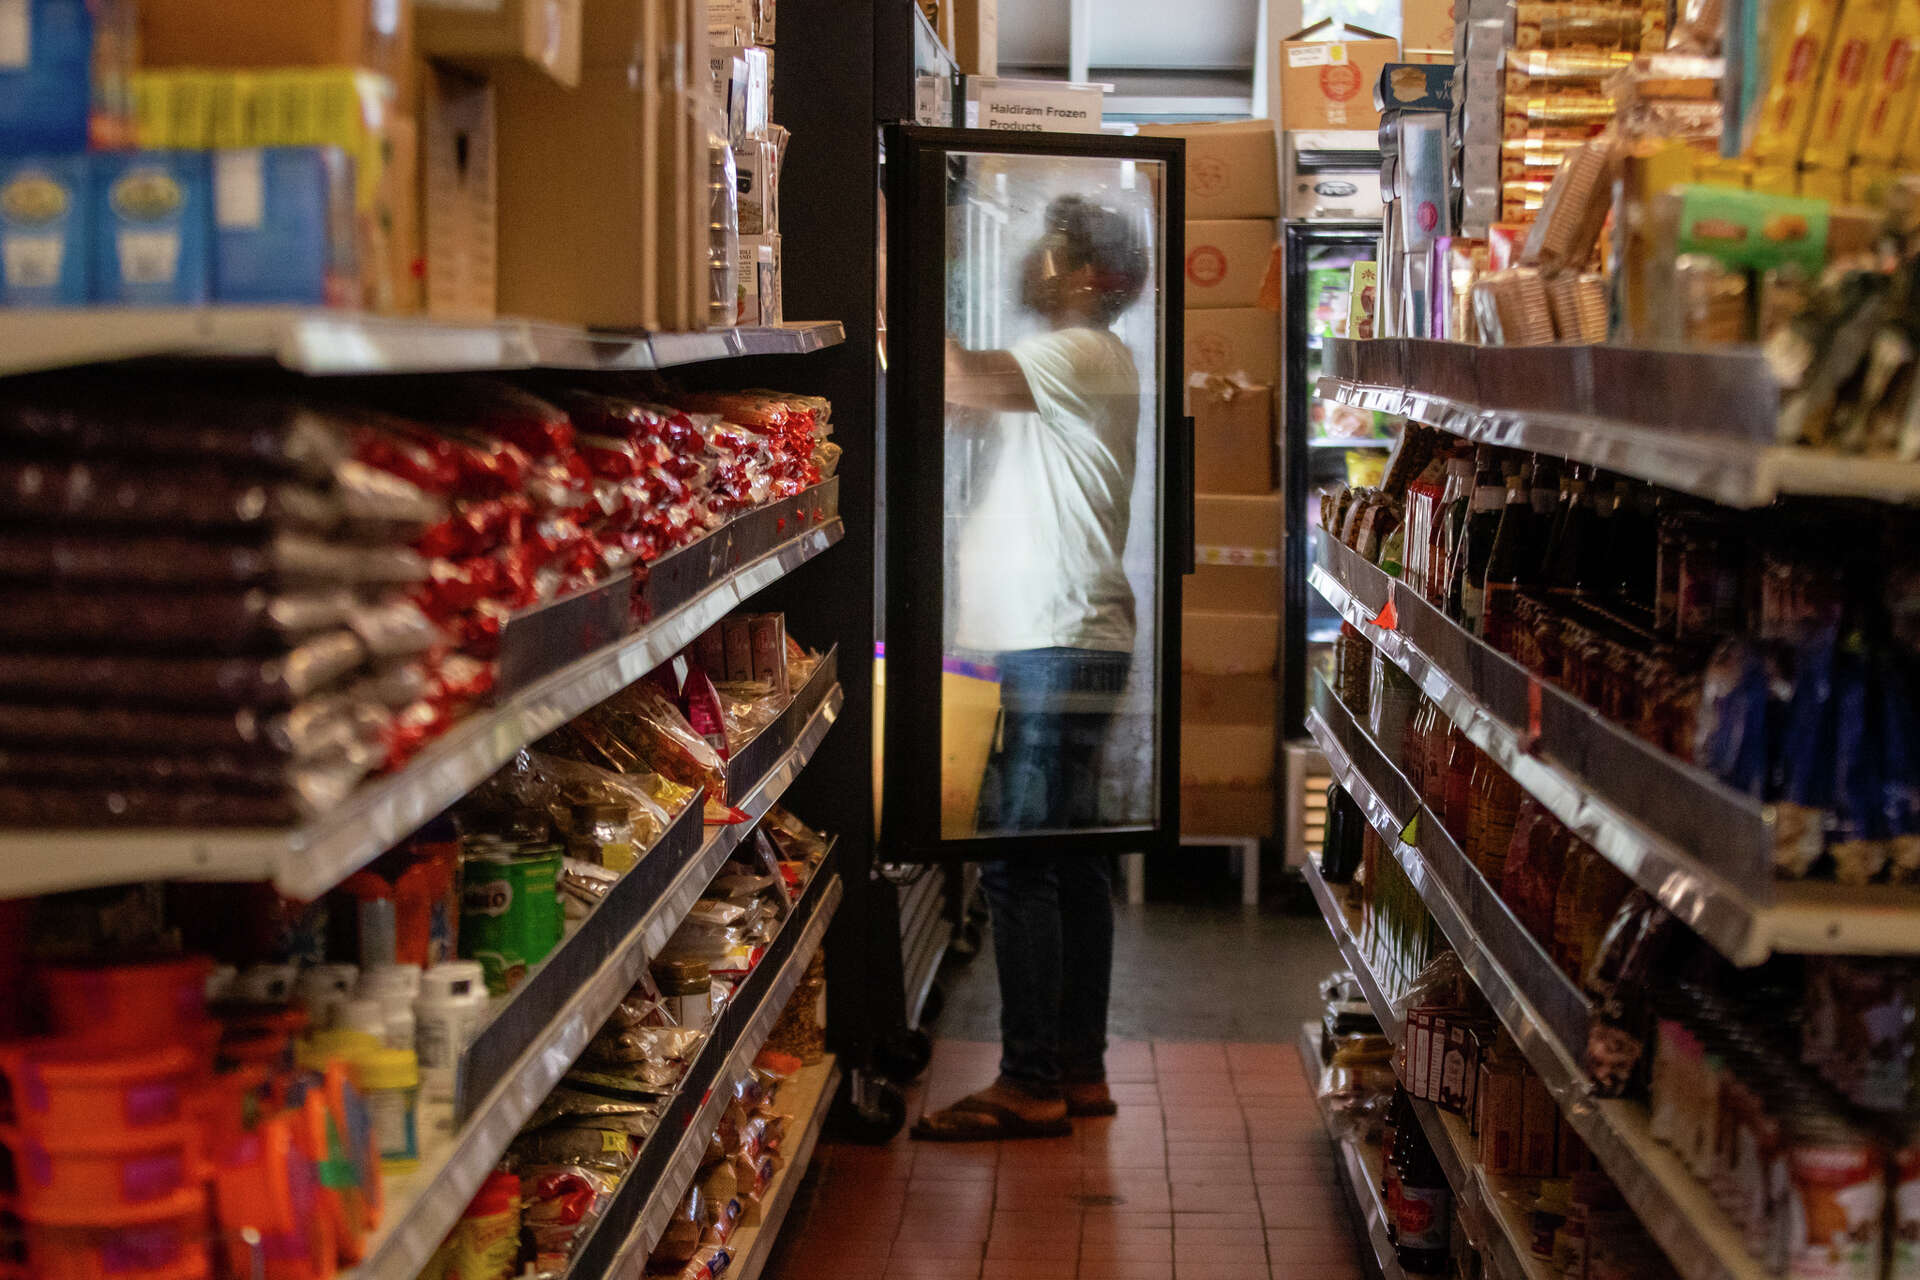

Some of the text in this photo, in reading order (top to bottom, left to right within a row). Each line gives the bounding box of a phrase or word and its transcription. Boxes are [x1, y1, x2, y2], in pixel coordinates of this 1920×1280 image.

[990, 103, 1087, 119] Haldiram Frozen
[989, 119, 1042, 131] Products
